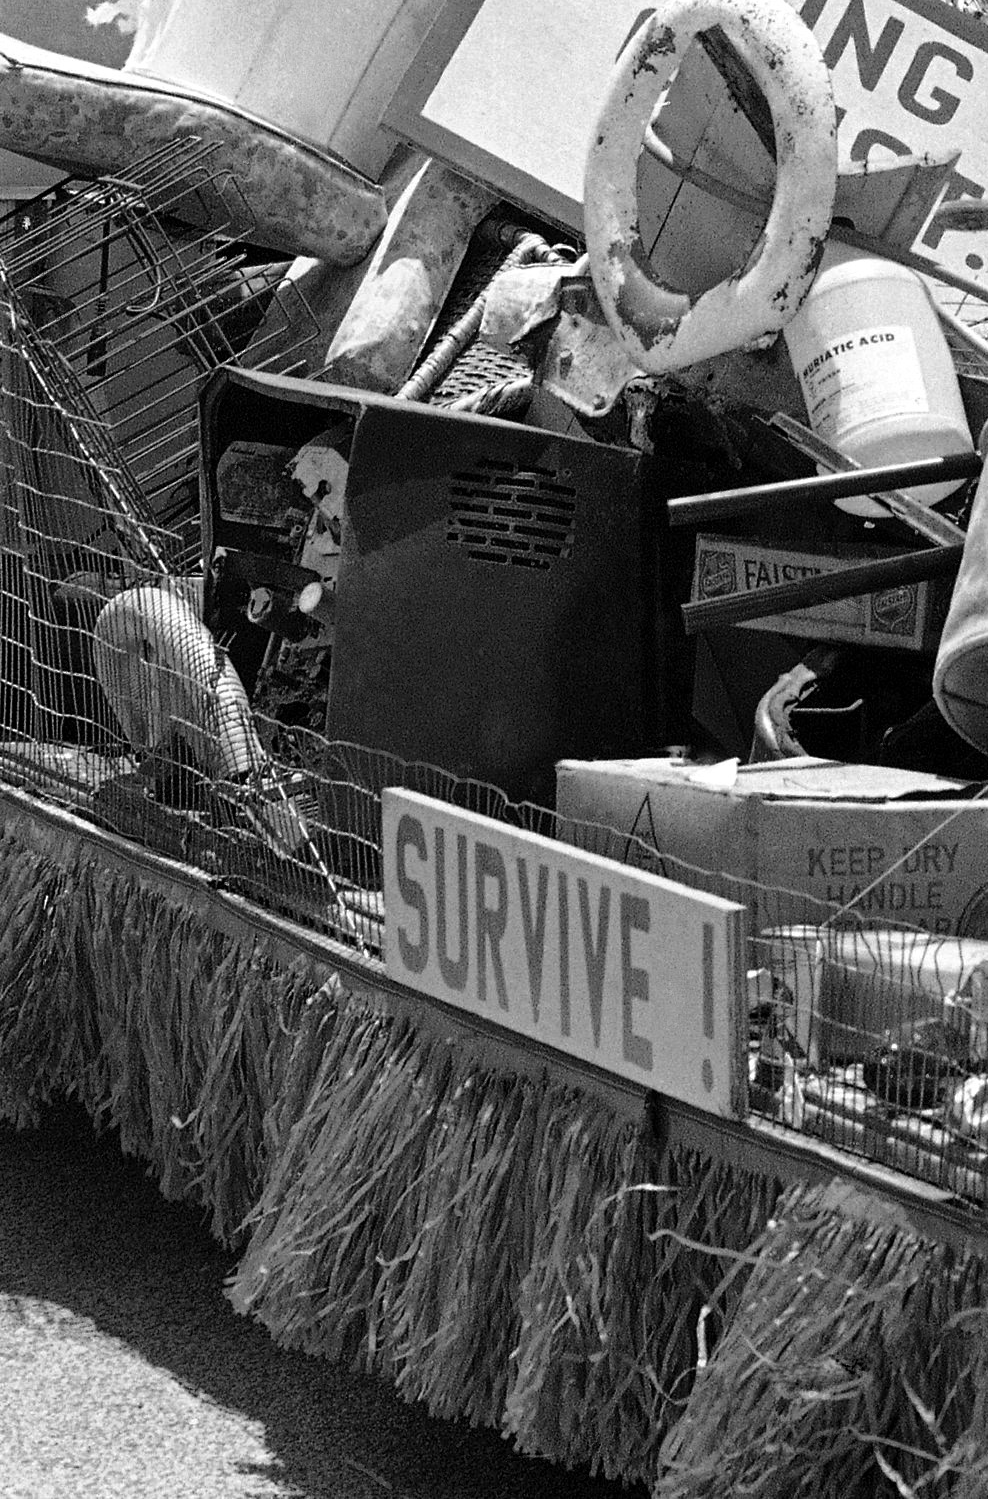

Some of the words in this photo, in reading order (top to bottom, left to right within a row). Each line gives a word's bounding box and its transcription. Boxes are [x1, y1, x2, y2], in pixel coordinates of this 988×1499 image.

[802, 340, 854, 380] MURIATIC
[859, 332, 896, 347] ACID
[808, 847, 885, 877] KEEP
[903, 843, 959, 874] DRY
[827, 882, 943, 910] HANDLE
[396, 814, 654, 1073] SURVIVE
[701, 922, 715, 1094] !
